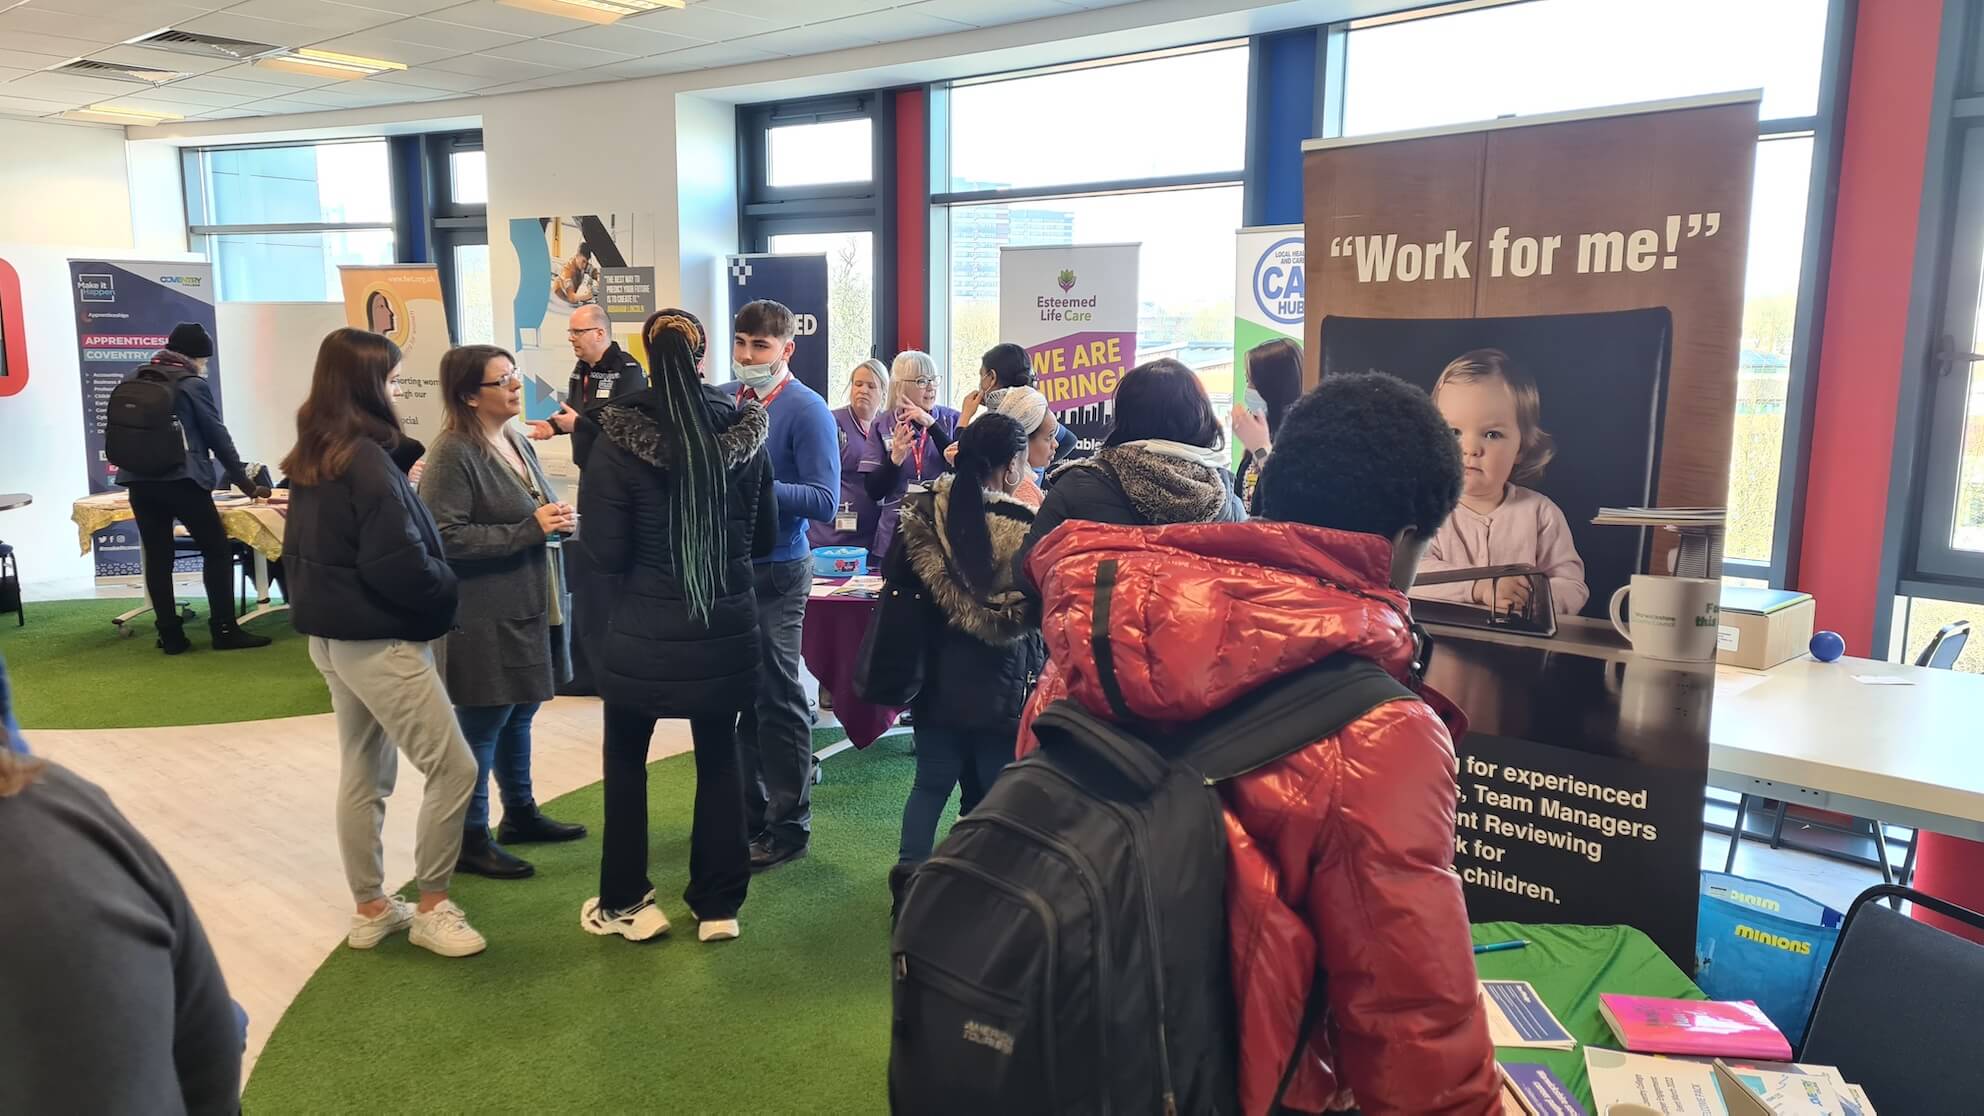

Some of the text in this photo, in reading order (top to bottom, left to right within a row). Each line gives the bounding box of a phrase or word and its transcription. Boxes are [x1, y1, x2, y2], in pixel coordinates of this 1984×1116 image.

[1275, 249, 1305, 258] LOCAL HEA
[1330, 212, 1721, 283] “Work for me!”
[1037, 295, 1097, 308] Esteemed
[1278, 301, 1305, 315] HUB
[1041, 308, 1092, 321] Life Care
[85, 336, 168, 345] APPRENTICES
[86, 350, 148, 359] COVENTRY
[1033, 337, 1122, 375] WE ARE
[1466, 755, 1499, 778] for
[1503, 765, 1648, 809] experienced
[1473, 783, 1534, 814] Team
[1540, 797, 1658, 842] Managers
[1453, 811, 1603, 863] nt Reviewing
[1473, 838, 1506, 862] for
[1463, 865, 1561, 905] children.
